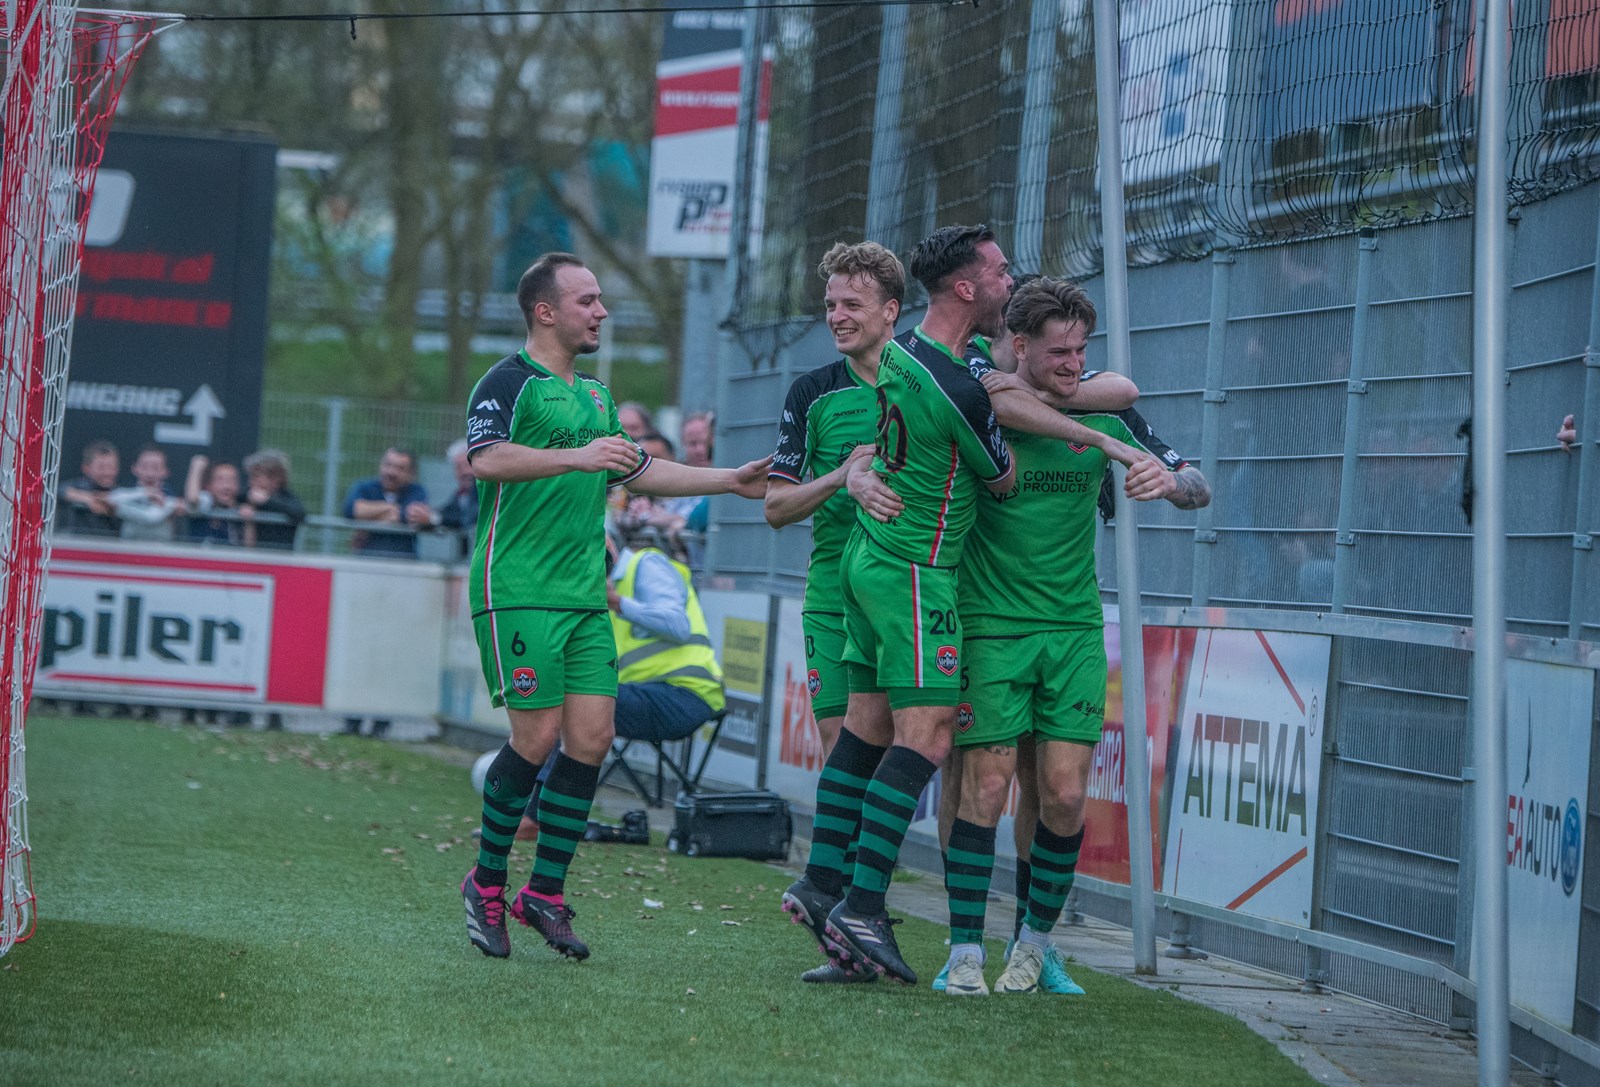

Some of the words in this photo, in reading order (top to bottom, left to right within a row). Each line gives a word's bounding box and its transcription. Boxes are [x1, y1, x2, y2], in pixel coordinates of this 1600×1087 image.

[886, 356, 922, 394] Euro-Rijn
[1023, 470, 1091, 482] CONNECT
[1023, 482, 1090, 493] PRODUCTS
[39, 592, 240, 669] piler
[928, 609, 957, 635] 20
[511, 631, 526, 657] 6
[1183, 712, 1307, 837] ATTEMA
[1524, 799, 1562, 883] AUTO
